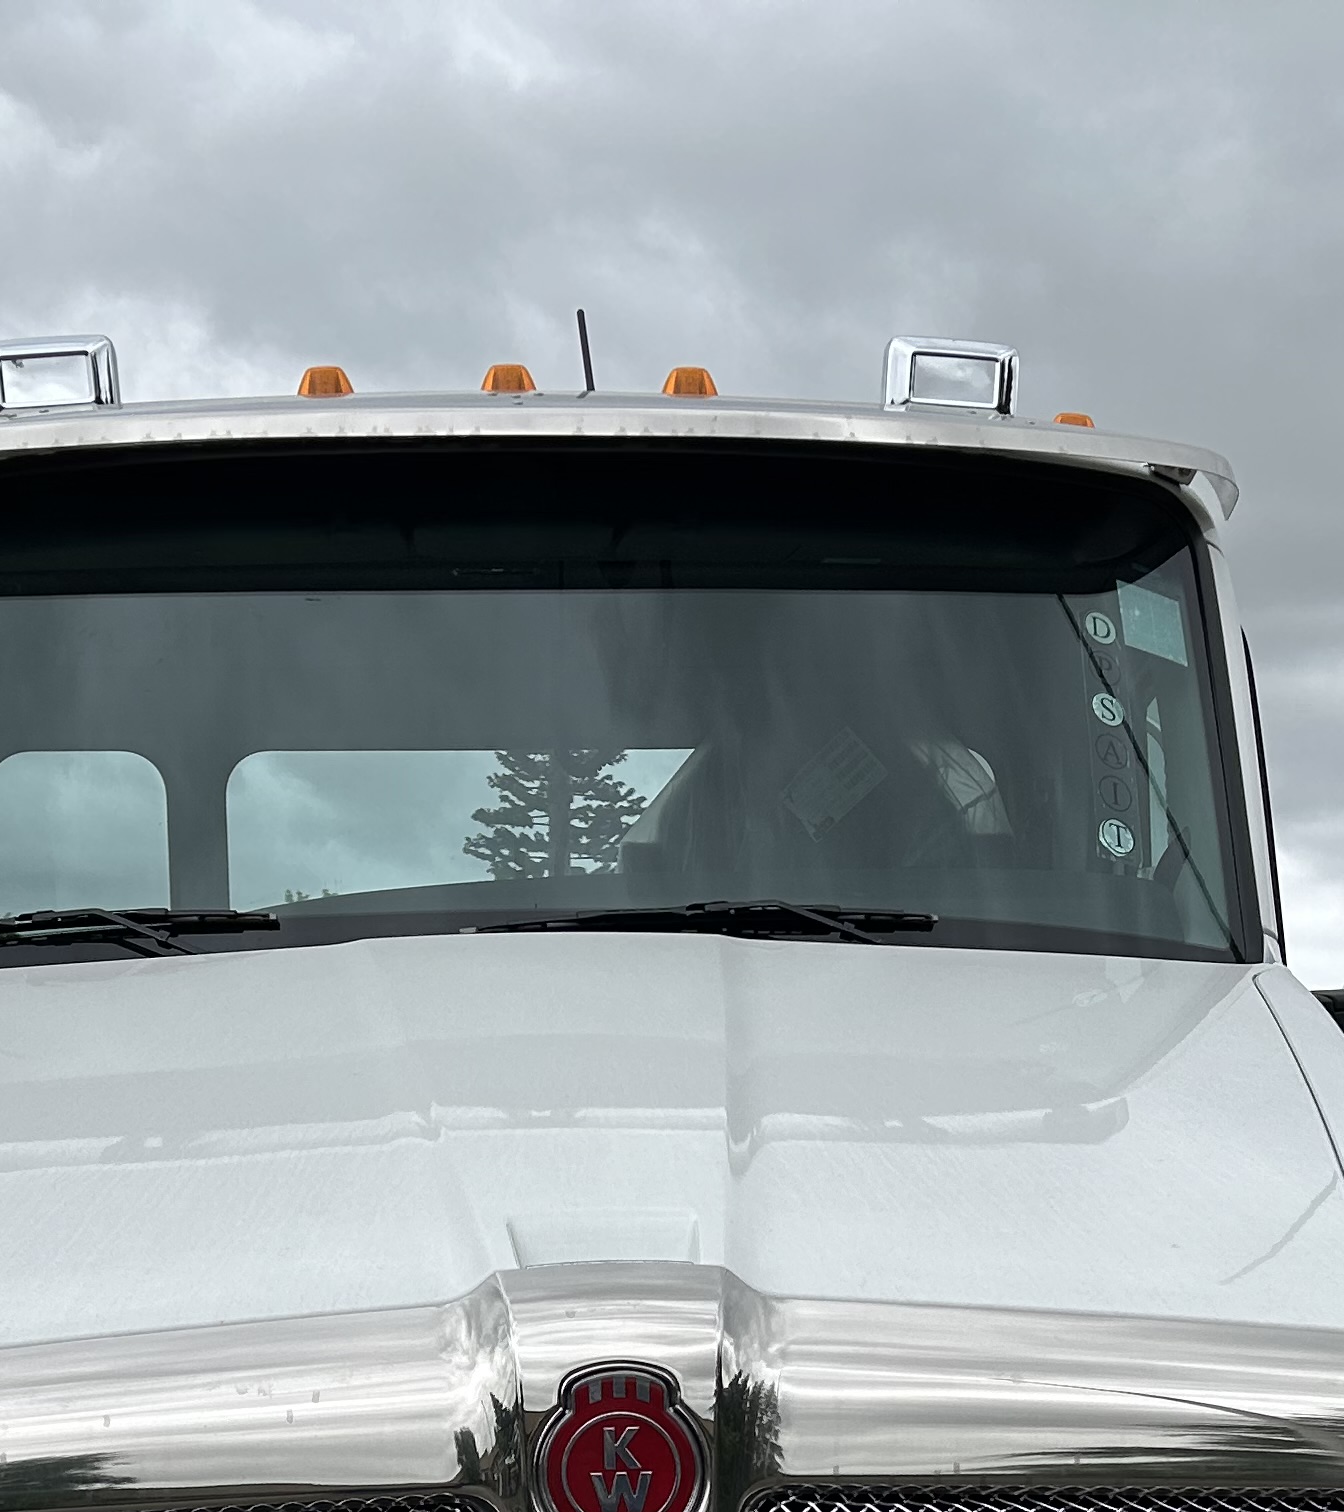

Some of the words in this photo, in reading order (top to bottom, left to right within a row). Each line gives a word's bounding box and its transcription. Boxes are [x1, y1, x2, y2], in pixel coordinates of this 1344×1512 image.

[1092, 617, 1111, 639] D
[1100, 697, 1116, 722] S
[1103, 741, 1123, 765] A
[1112, 782, 1121, 806] I
[1108, 823, 1127, 848] T
